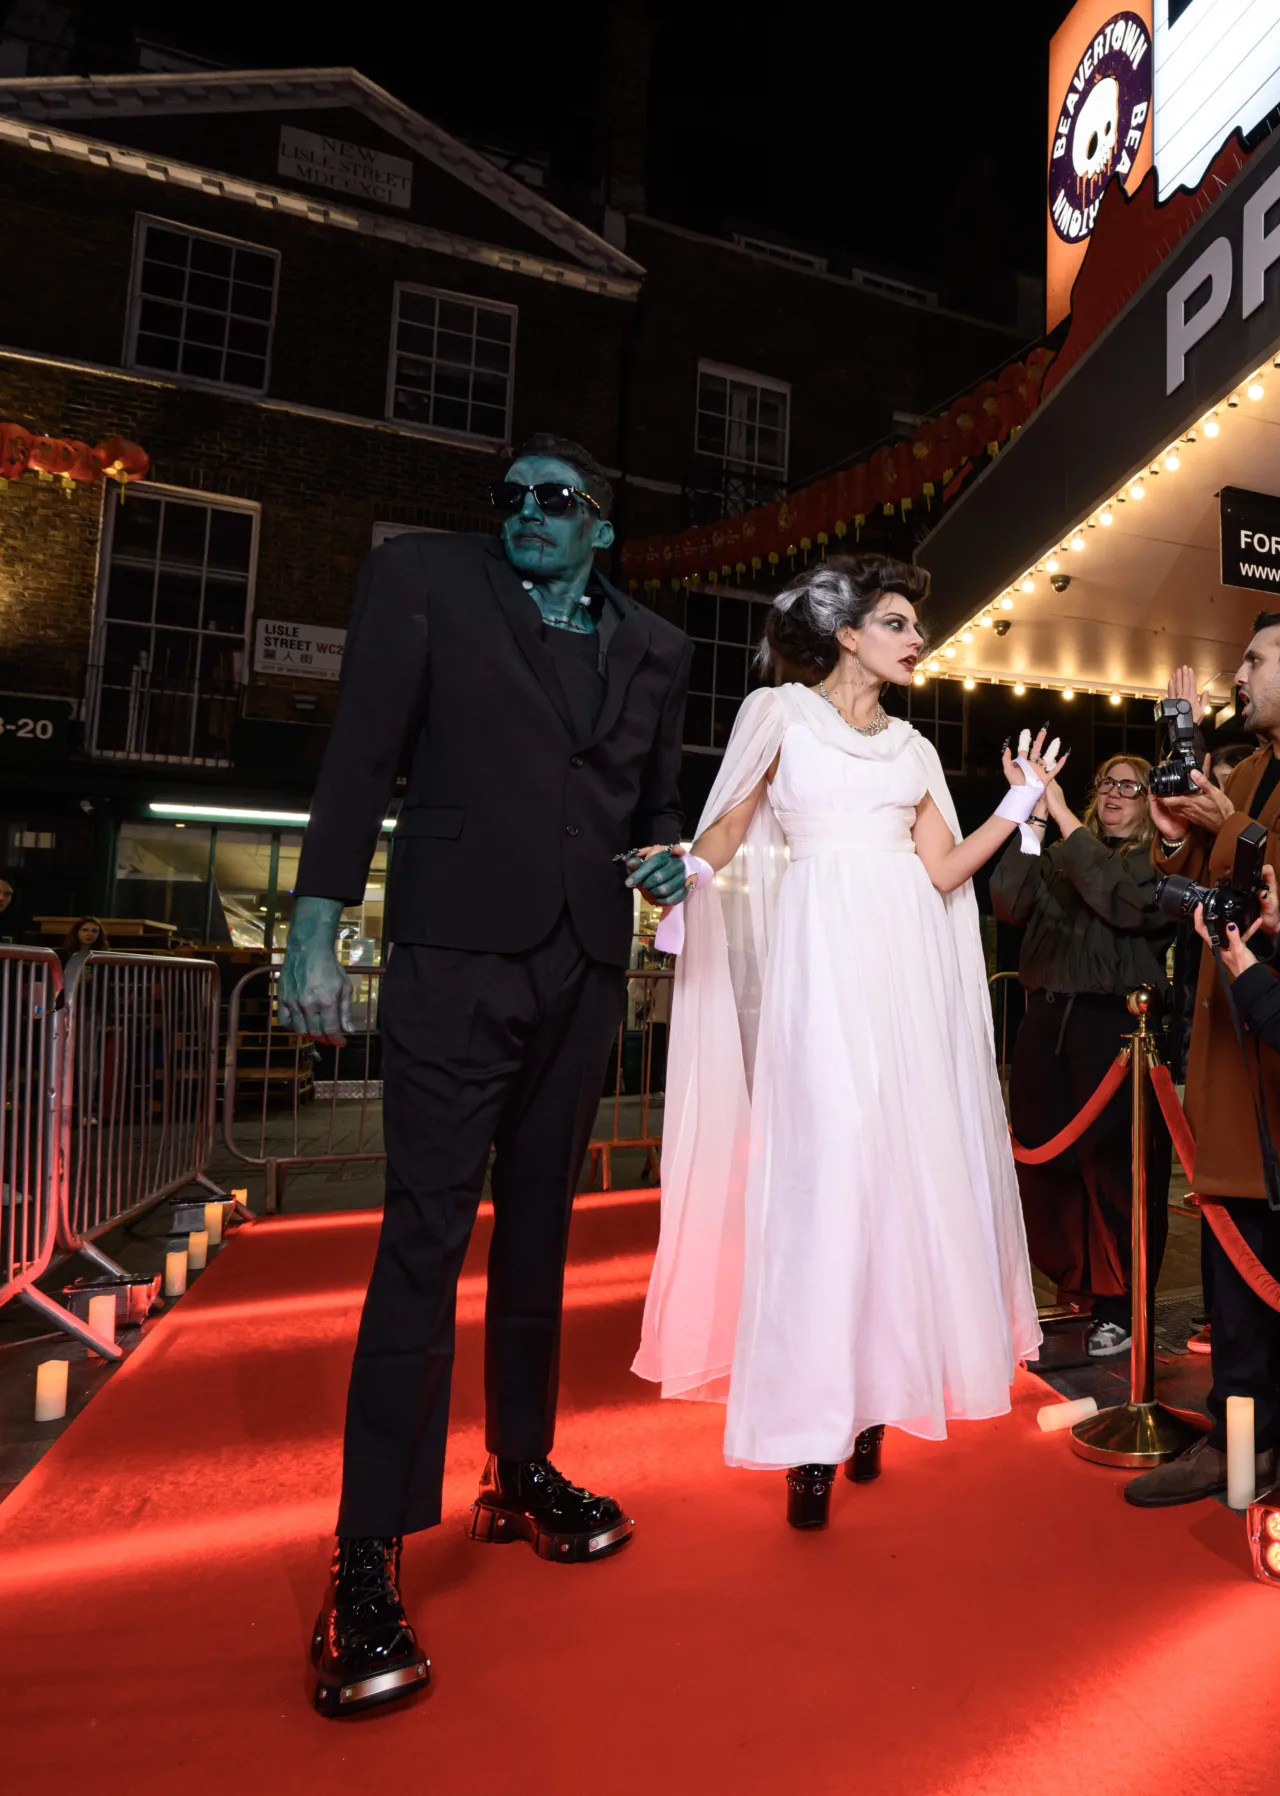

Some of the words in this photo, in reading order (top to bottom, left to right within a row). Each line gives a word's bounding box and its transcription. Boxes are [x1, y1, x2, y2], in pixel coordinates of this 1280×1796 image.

[1053, 20, 1148, 159] BEAVERTOWN
[281, 142, 335, 170] LISLE
[340, 161, 413, 190] STREET
[321, 137, 379, 163] NEW
[296, 164, 393, 202] MDCCXCI
[1053, 101, 1148, 238] BEARTOWN
[264, 636, 312, 652] STREET
[265, 623, 299, 637] LISLE
[0, 717, 53, 739] -20
